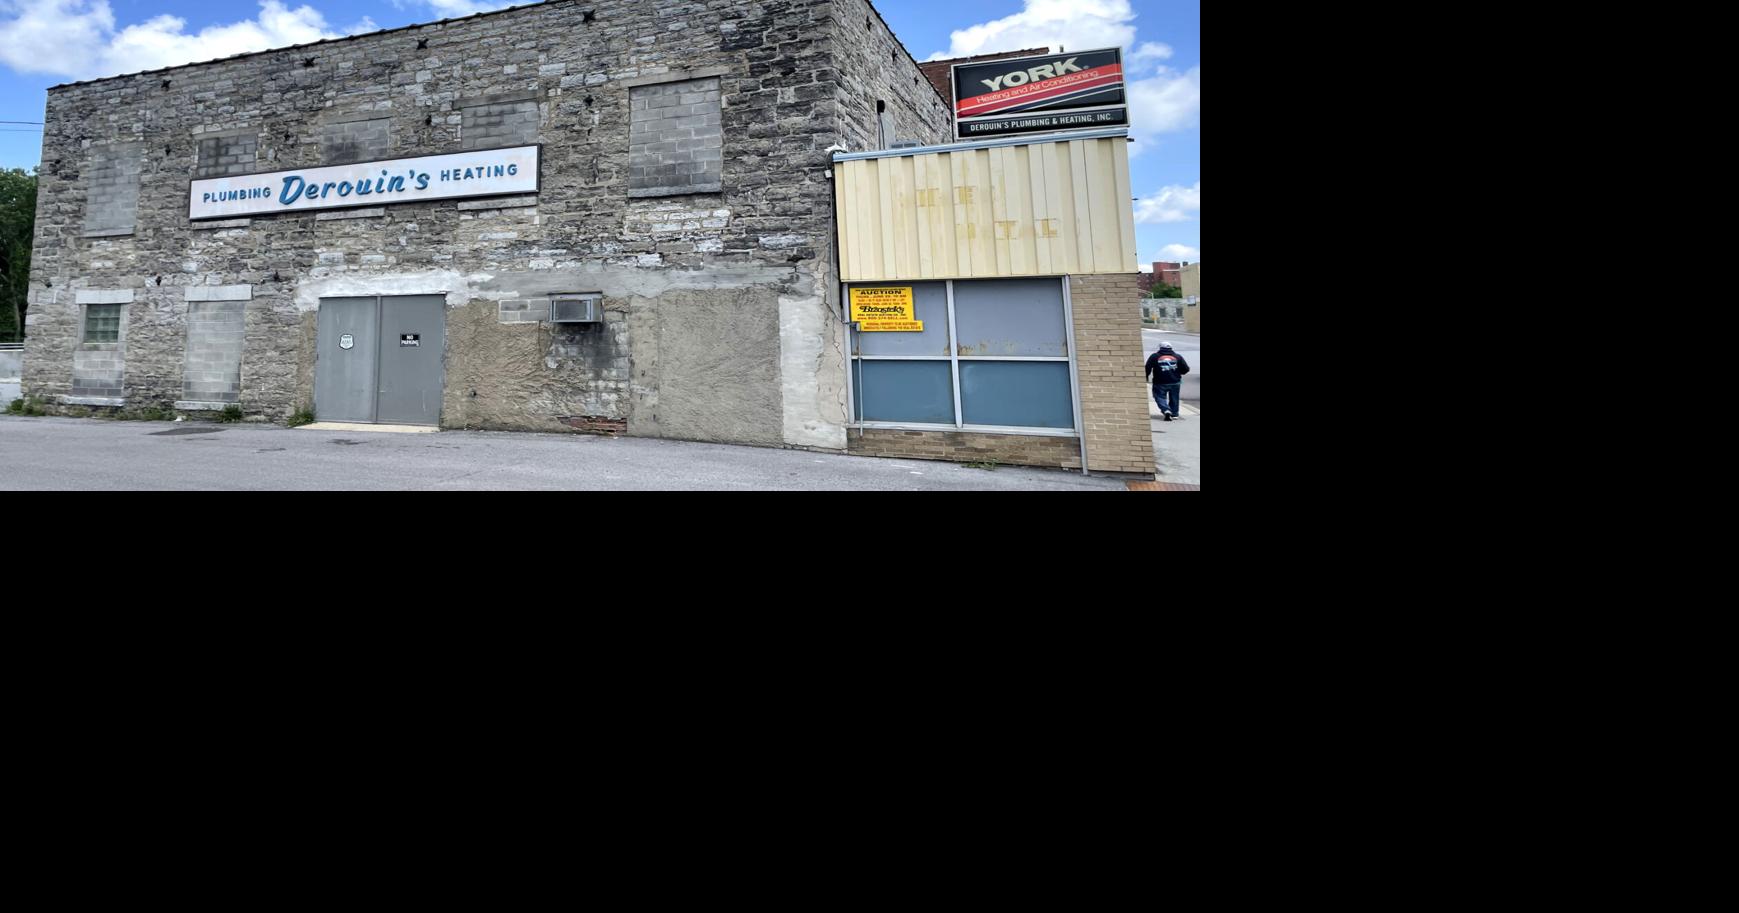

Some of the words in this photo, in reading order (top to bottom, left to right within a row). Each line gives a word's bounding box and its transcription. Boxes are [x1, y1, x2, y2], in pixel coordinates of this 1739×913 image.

[976, 91, 1010, 103] Heating
[1011, 87, 1028, 96] and
[1029, 83, 1041, 92] Air
[1041, 71, 1099, 88] Conditioning
[981, 57, 1083, 92] YORK
[970, 121, 1010, 132] DEROUIN'S
[1011, 118, 1050, 128] PLUMBING
[1052, 117, 1058, 125] &
[1060, 114, 1095, 125] HEATING,
[203, 187, 272, 203] PLUMBING
[278, 169, 431, 206] Derouin's
[440, 164, 518, 182] HEATING
